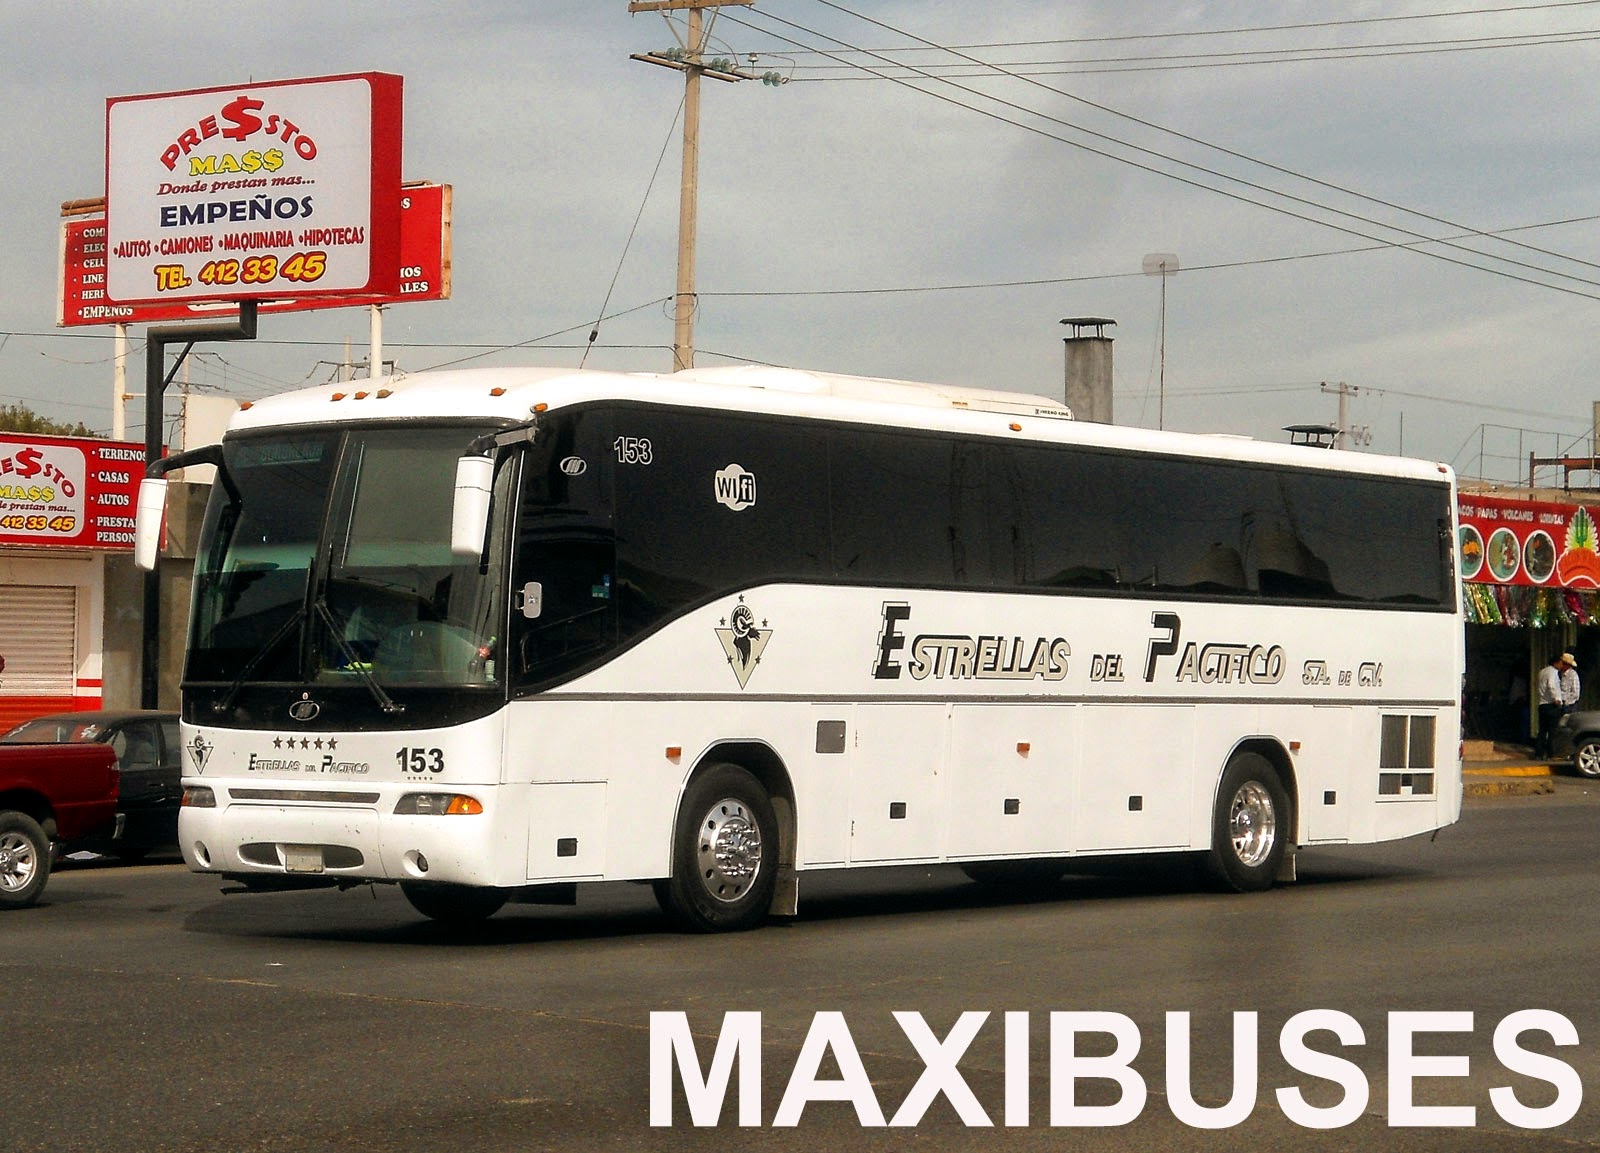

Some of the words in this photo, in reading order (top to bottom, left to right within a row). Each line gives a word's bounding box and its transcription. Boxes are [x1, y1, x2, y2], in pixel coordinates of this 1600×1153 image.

[157, 180, 207, 196] Donde
[211, 177, 267, 194] prestan
[270, 175, 315, 188] mas...
[159, 193, 314, 228] EMPEÑOS
[118, 240, 151, 258] AUTOS
[159, 235, 214, 256] CAMIONES
[223, 229, 295, 251] MAQUINARIA
[302, 225, 365, 247] HIPOTECAS
[154, 263, 193, 292] TEL.
[198, 258, 240, 286] 412
[239, 254, 279, 285] 33
[278, 251, 328, 283] 45
[613, 435, 653, 465] 153
[97, 471, 130, 484] CASAS
[8, 502, 46, 512] prestan
[97, 494, 130, 506] AUTOS
[0, 514, 25, 530] 412
[25, 515, 48, 531] 33
[48, 516, 76, 533] 45
[870, 600, 1072, 681] ESTRELLAS
[1089, 653, 1125, 683] DEL
[1142, 610, 1287, 685] PACIFICO
[1338, 670, 1353, 687] DE
[248, 752, 301, 772] ESTRELLAS
[395, 746, 446, 774] 153
